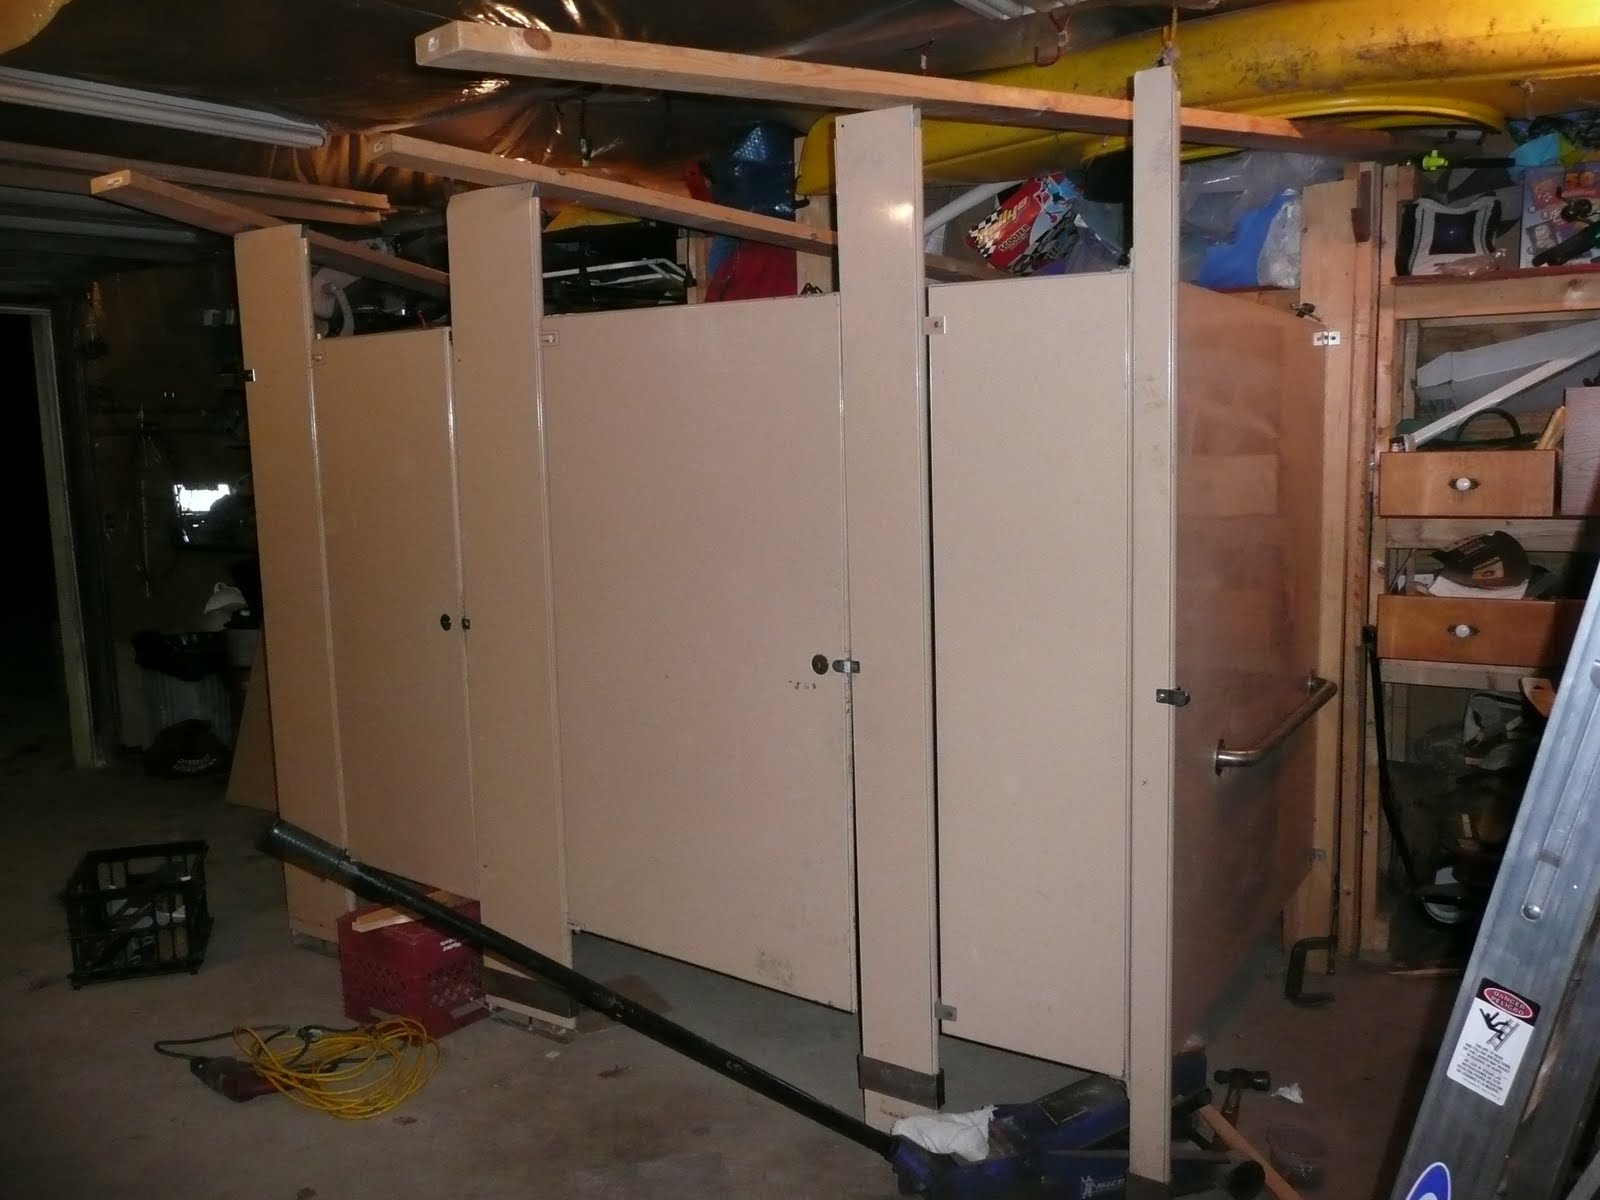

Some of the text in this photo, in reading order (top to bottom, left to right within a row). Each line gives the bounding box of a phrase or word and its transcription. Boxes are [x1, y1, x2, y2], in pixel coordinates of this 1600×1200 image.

[999, 225, 1030, 252] SCOOTER
[1490, 995, 1525, 1016] PELIGRO
[1493, 990, 1526, 1010] DANGER
